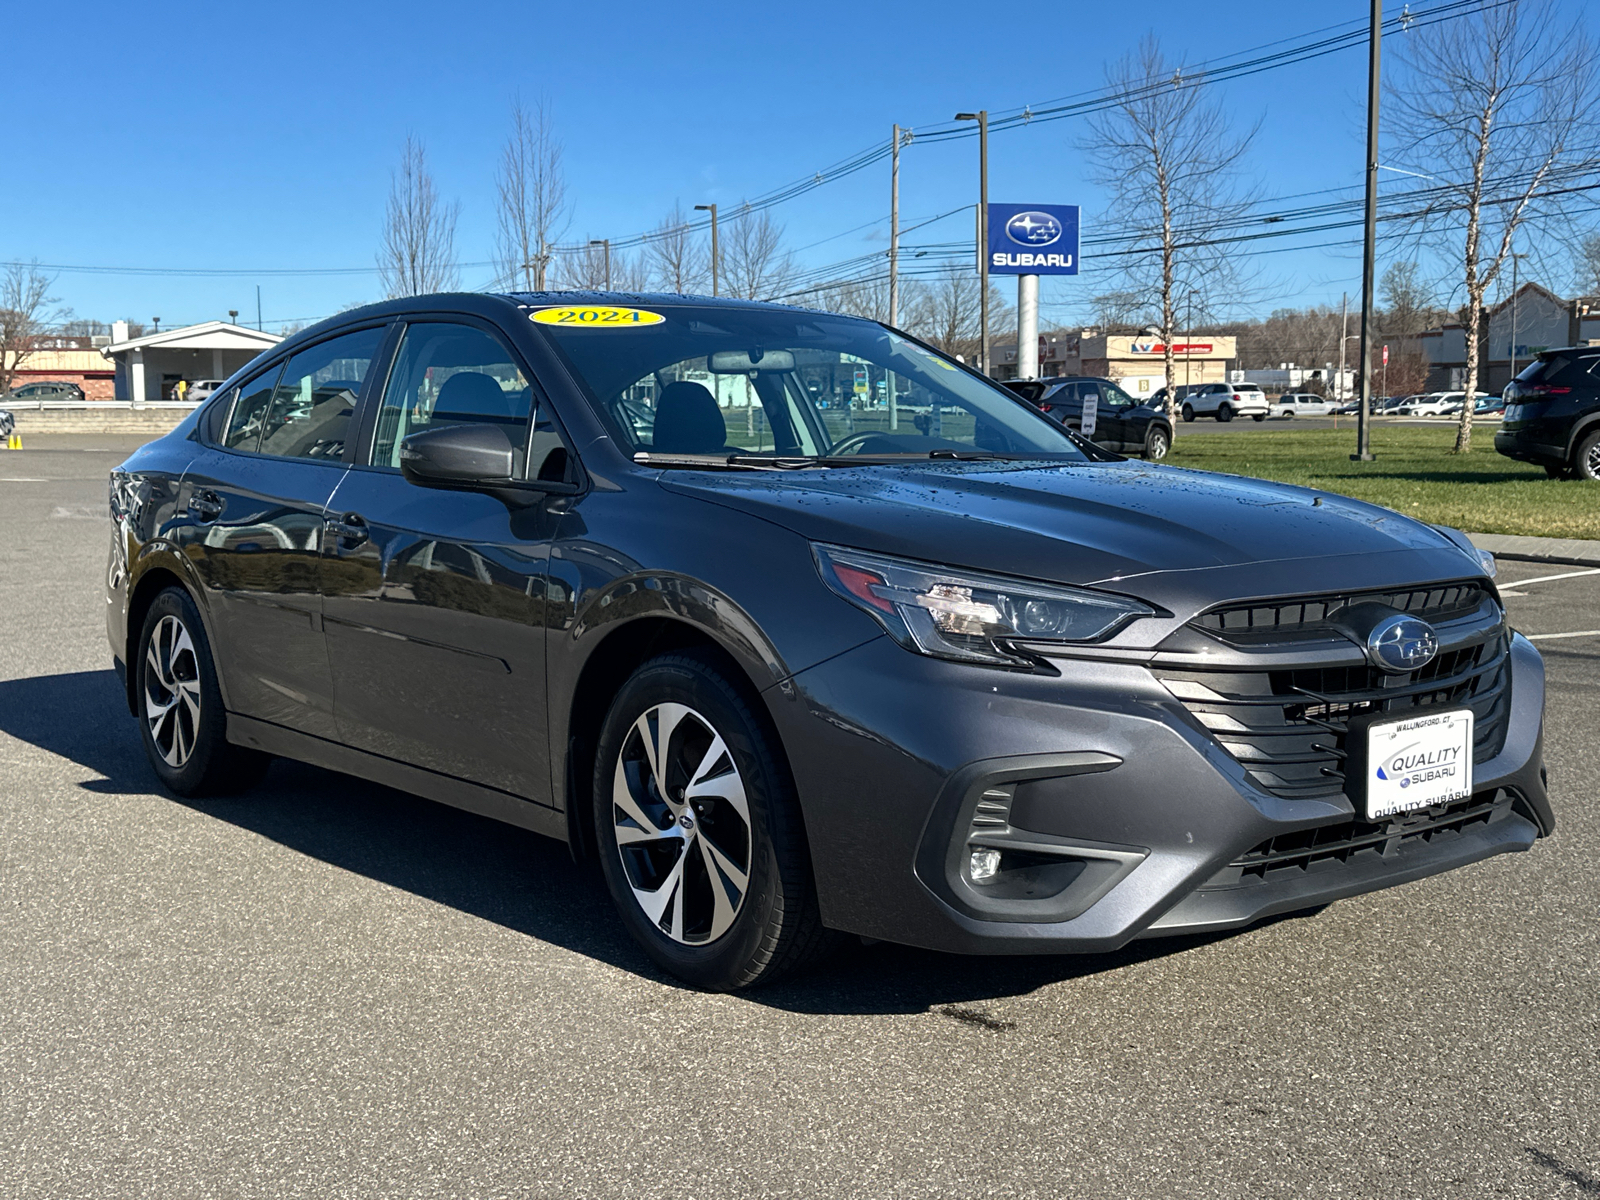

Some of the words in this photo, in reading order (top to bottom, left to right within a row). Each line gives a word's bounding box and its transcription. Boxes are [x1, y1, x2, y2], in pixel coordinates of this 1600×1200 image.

[992, 252, 1073, 267] SUBARU
[557, 311, 643, 323] 2024
[1392, 745, 1461, 771] QUALITY
[1411, 766, 1456, 784] SUBARU
[1374, 800, 1422, 818] QUALITY
[1425, 789, 1469, 807] SUBARU
